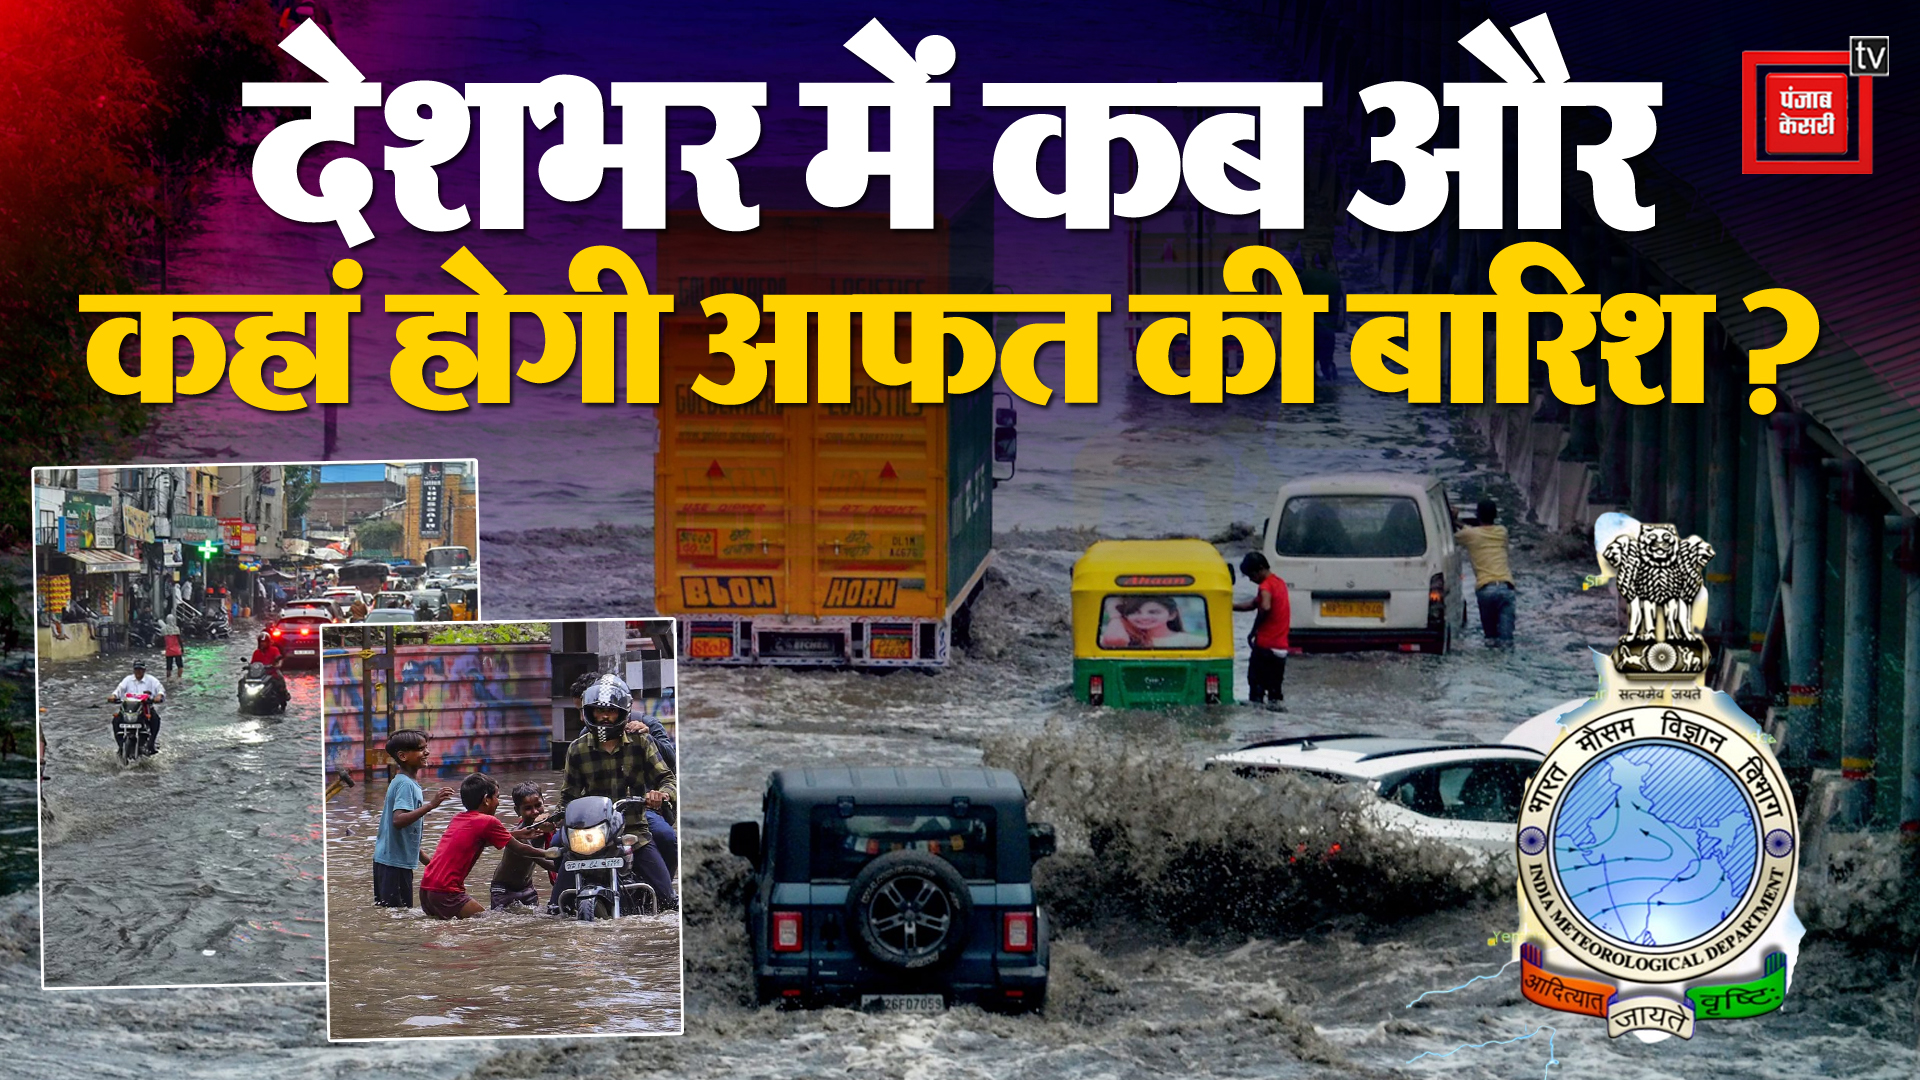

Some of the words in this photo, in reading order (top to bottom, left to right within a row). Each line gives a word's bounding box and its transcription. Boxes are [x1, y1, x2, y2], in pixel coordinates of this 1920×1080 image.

[682, 503, 709, 513] USE
[682, 576, 776, 607] BLOW
[823, 577, 898, 608] HORN
